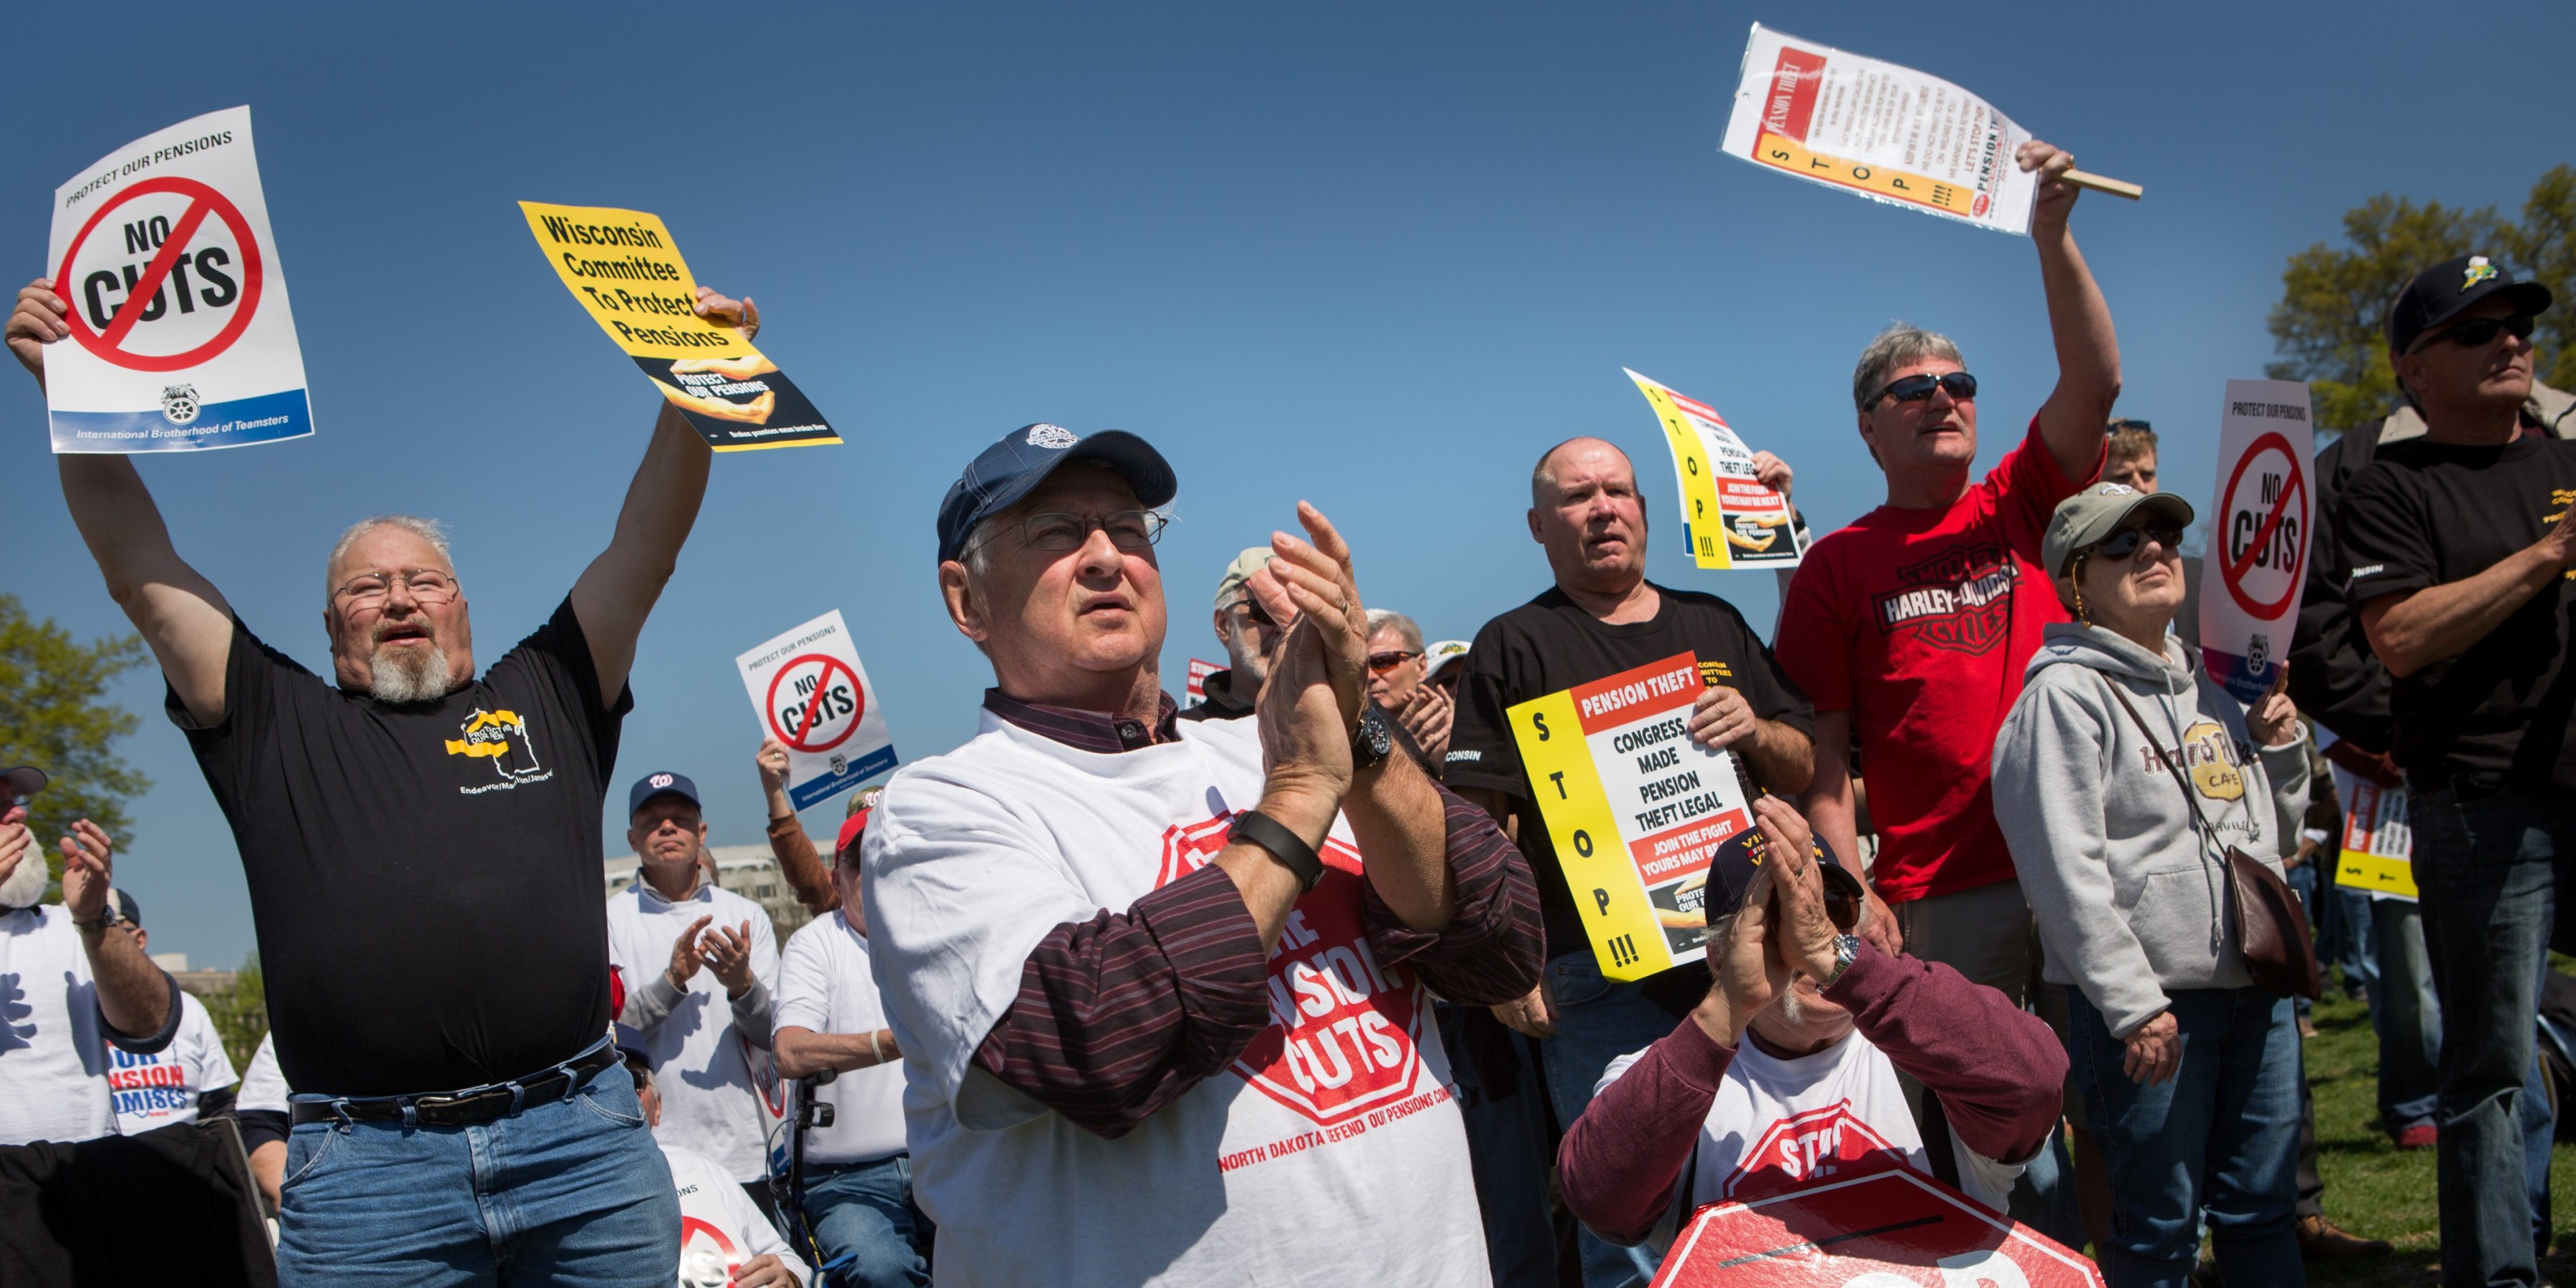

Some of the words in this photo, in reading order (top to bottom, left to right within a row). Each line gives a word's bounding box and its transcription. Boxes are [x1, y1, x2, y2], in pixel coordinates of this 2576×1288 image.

[1777, 61, 1801, 94] THEFT
[1766, 92, 1792, 134] PENSION
[1969, 122, 1982, 145] STOP
[66, 169, 119, 208] PROTECT
[122, 155, 150, 175] OUR
[155, 131, 231, 163] PENSIONS
[1963, 147, 1978, 173] LET'S
[1977, 132, 1997, 191] PENSION
[1973, 193, 1985, 217] STOP
[123, 216, 170, 255] NO
[540, 215, 663, 248] Wisconsin
[563, 252, 680, 281] Committee
[84, 247, 238, 330] CUTS
[581, 286, 619, 311] To
[614, 289, 695, 316] Protect
[611, 320, 730, 347] Pensions
[674, 373, 727, 385] PROTECT
[685, 384, 714, 397] OUR
[709, 380, 770, 397] PENSIONS
[77, 430, 148, 439] International
[151, 423, 219, 438] Brotherhood
[222, 422, 233, 432] of
[235, 414, 289, 431] Teamsters
[2232, 402, 2265, 417] PROTECT
[2266, 402, 2279, 418] OUR
[2279, 404, 2306, 422] PENSIONS
[1720, 461, 1742, 474] THEFT
[1743, 462, 1756, 475] LEG
[2261, 473, 2281, 505] NO
[2231, 509, 2298, 574] CUTS
[1933, 604, 2007, 646] CYCLES
[748, 649, 779, 672] PROTECT
[780, 642, 797, 656] OUR
[797, 625, 836, 647] PENSIONS
[794, 674, 817, 697] NO
[1581, 681, 1649, 718] PENSION
[1647, 666, 1695, 697] THEFT
[782, 685, 854, 736] CUTS
[1614, 717, 1686, 754] CONGRESS
[1444, 750, 1482, 762] CONSIN
[1637, 746, 1680, 775] MADE
[830, 770, 859, 788] Brotherhood
[1639, 770, 1701, 804] PENSION
[1635, 803, 1678, 832] THEFT
[1678, 791, 1722, 818] LEGAL
[1654, 837, 1680, 856] JOIN
[1678, 831, 1702, 848] THE
[1700, 820, 1733, 841] FIGHT
[1641, 854, 1681, 876] YOURS
[1678, 846, 1704, 866] MAY
[1704, 842, 1719, 858] BE
[1676, 888, 1704, 904] PROTE
[1678, 900, 1698, 912] OUR
[1270, 937, 1404, 1034] NSION
[1286, 1011, 1402, 1095] CUTS
[108, 1065, 184, 1090] NSION
[112, 1088, 187, 1113] OMISES
[1217, 1146, 1266, 1173] NORTH
[1269, 1130, 1324, 1158] DAKOTA
[1327, 1118, 1366, 1143] DEFEND
[1386, 1093, 1434, 1123] PENSIONS
